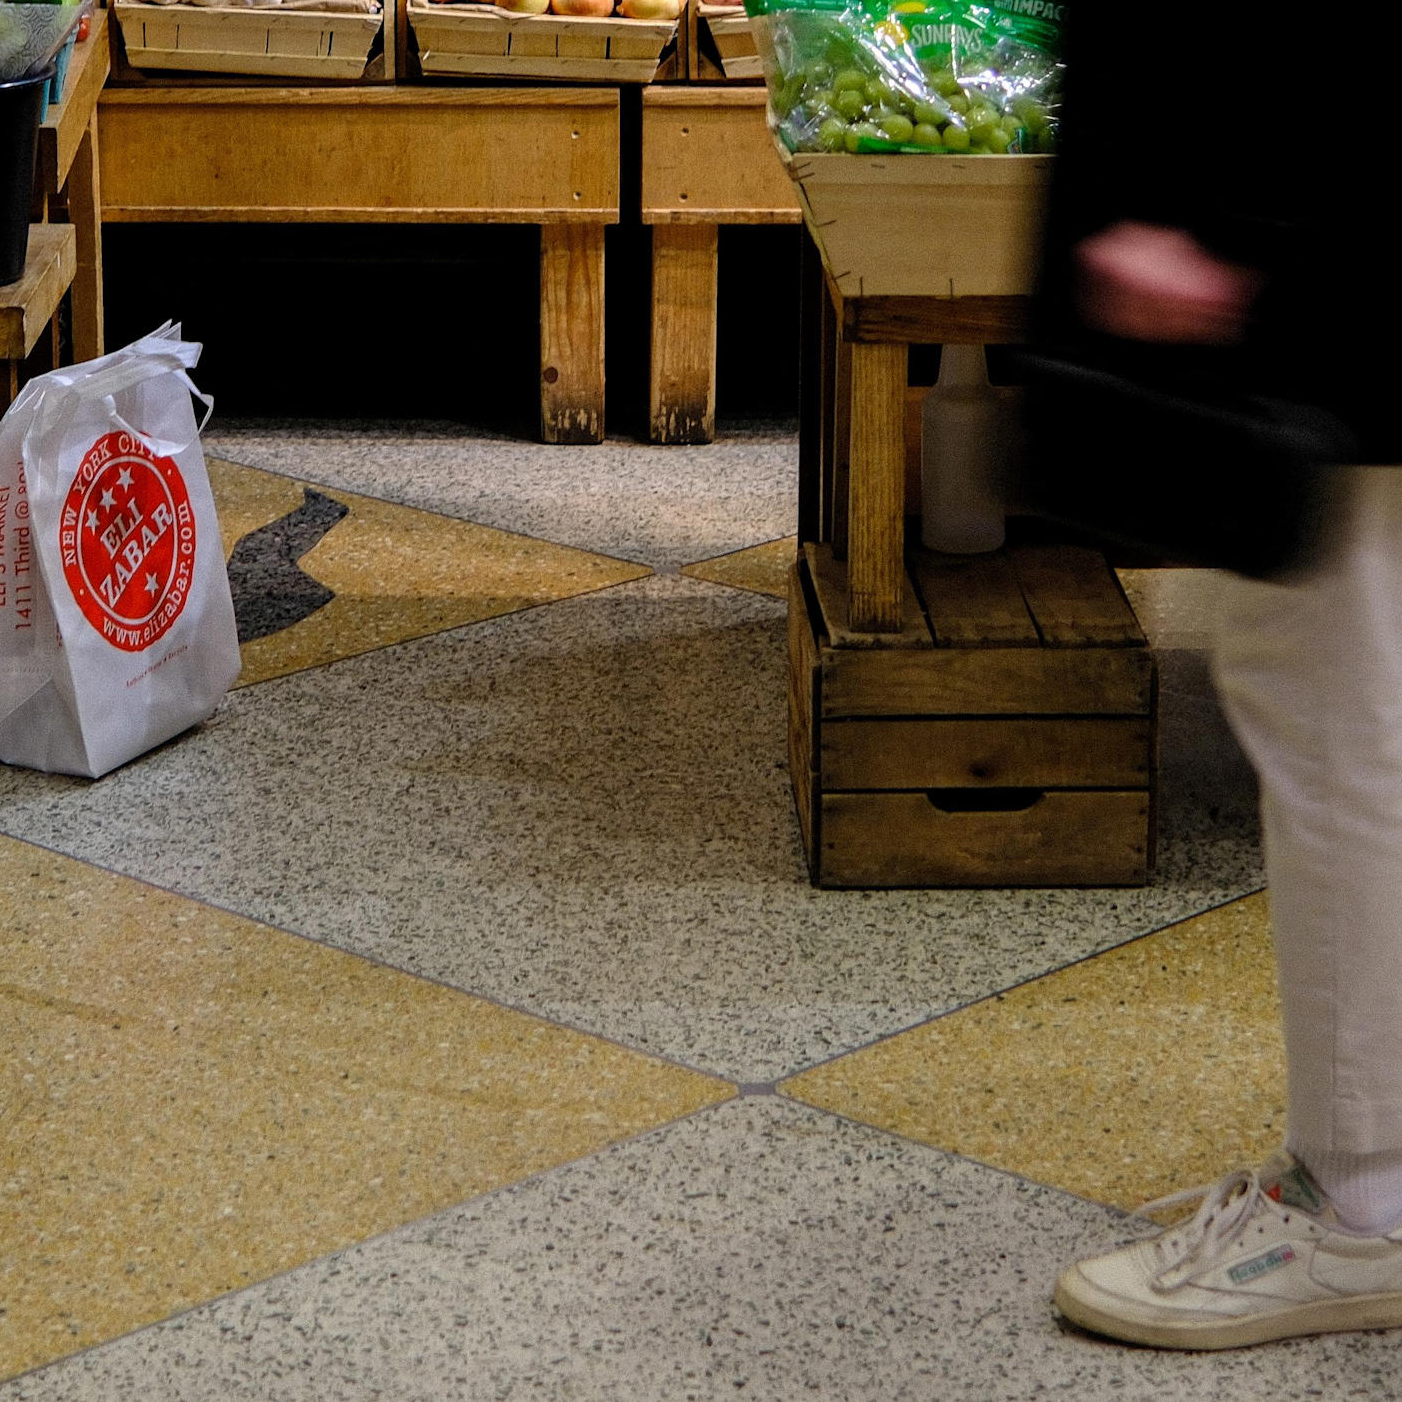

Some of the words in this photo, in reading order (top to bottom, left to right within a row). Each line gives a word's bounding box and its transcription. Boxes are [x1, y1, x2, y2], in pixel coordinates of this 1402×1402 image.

[14, 500, 29, 519] @
[63, 504, 78, 567] NEW
[73, 439, 113, 496] YORK
[100, 497, 144, 560] ELI
[14, 526, 30, 575] Third
[99, 502, 173, 609] ZABAR
[103, 500, 193, 647] www.elizabar.com
[15, 585, 32, 629] 1411
